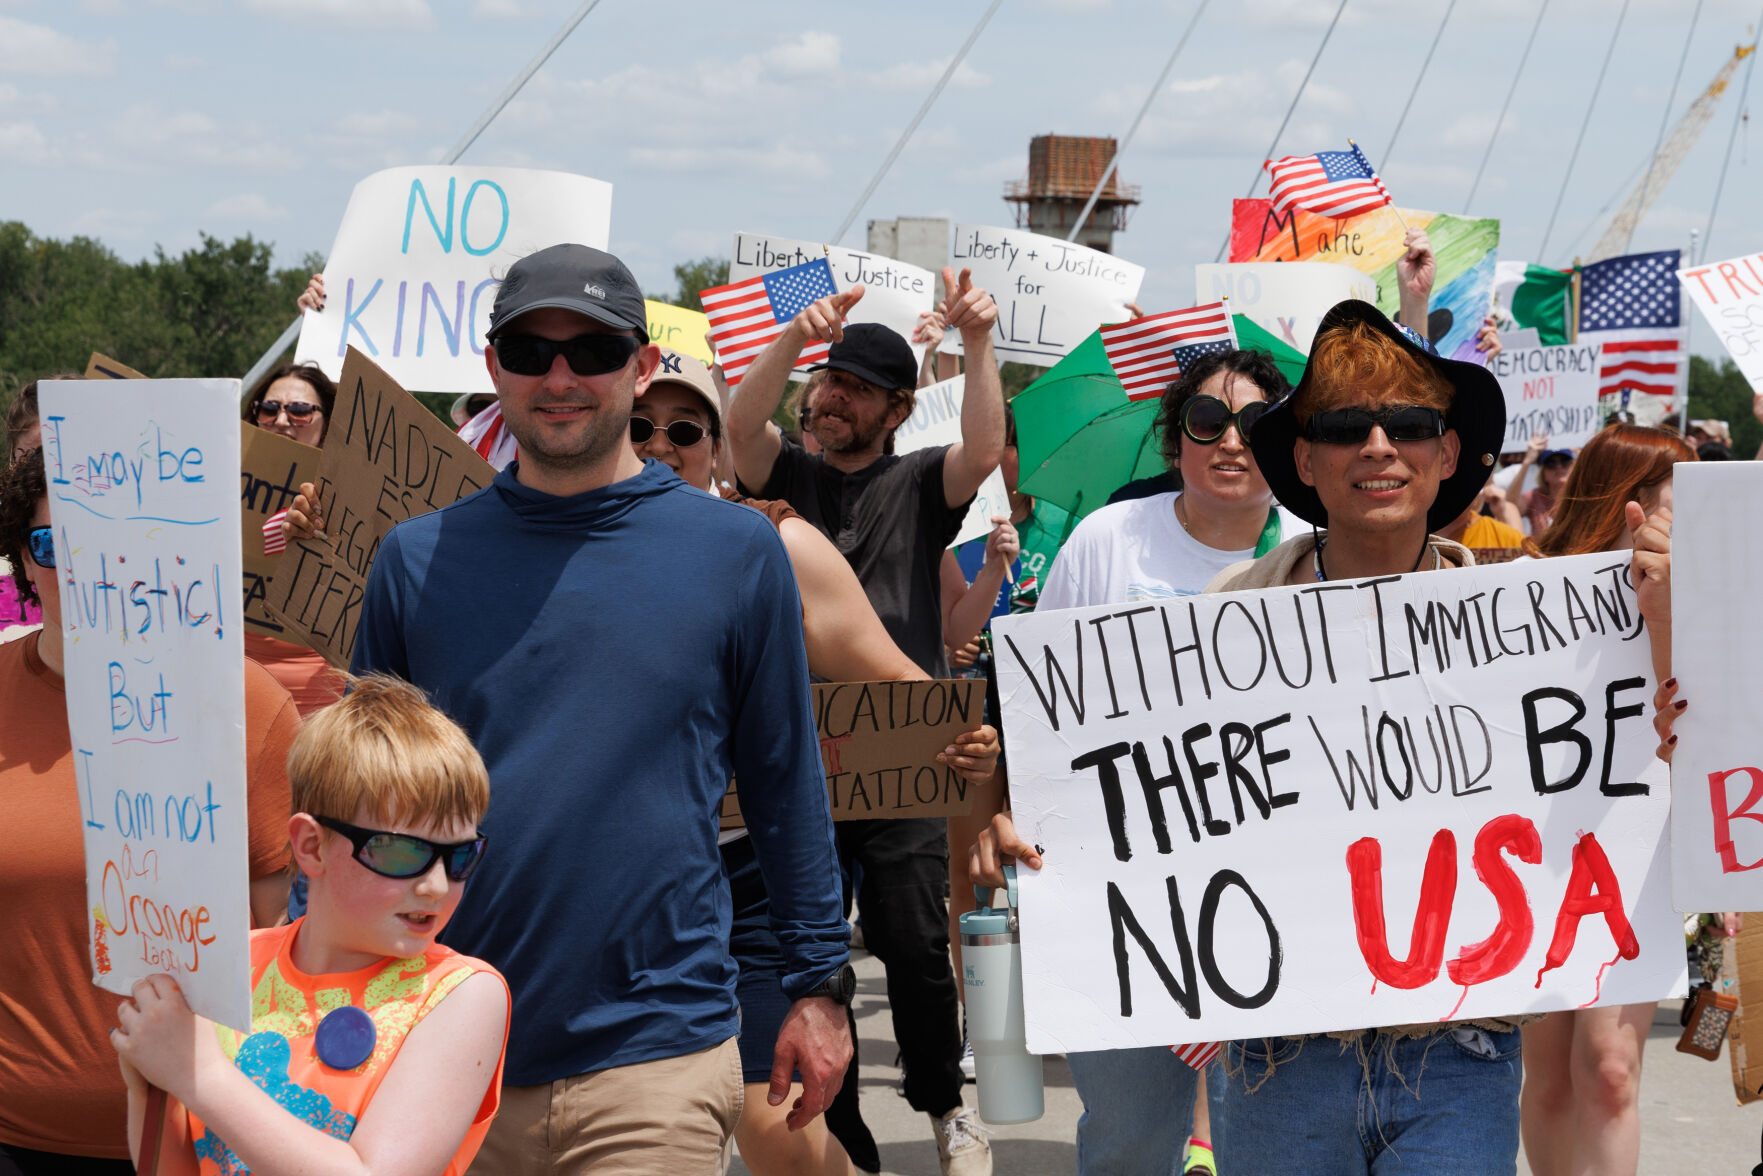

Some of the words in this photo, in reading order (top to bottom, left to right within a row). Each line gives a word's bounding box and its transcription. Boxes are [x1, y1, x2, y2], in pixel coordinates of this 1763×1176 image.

[402, 176, 509, 256] NO
[953, 227, 1019, 272] Liberty
[1045, 244, 1128, 286] Justice
[845, 253, 925, 293] Justice
[1014, 275, 1046, 296] for
[898, 384, 961, 437] ONK
[1522, 374, 1558, 402] NOT
[48, 416, 71, 485] I
[87, 451, 143, 511] may
[157, 426, 206, 483] be
[60, 525, 223, 640] Autistic!
[1003, 585, 1354, 732] WITHOUT
[1356, 562, 1644, 683] IMMIGRANTS
[109, 661, 174, 735] But
[78, 748, 106, 831] I
[115, 789, 155, 841] am
[165, 781, 222, 844] not
[1070, 712, 1301, 863] THERE
[1307, 704, 1493, 812] WOULD
[1521, 675, 1651, 798] BE
[102, 860, 217, 972] Orange
[1106, 868, 1284, 1020] NO
[1345, 813, 1641, 993] USA
